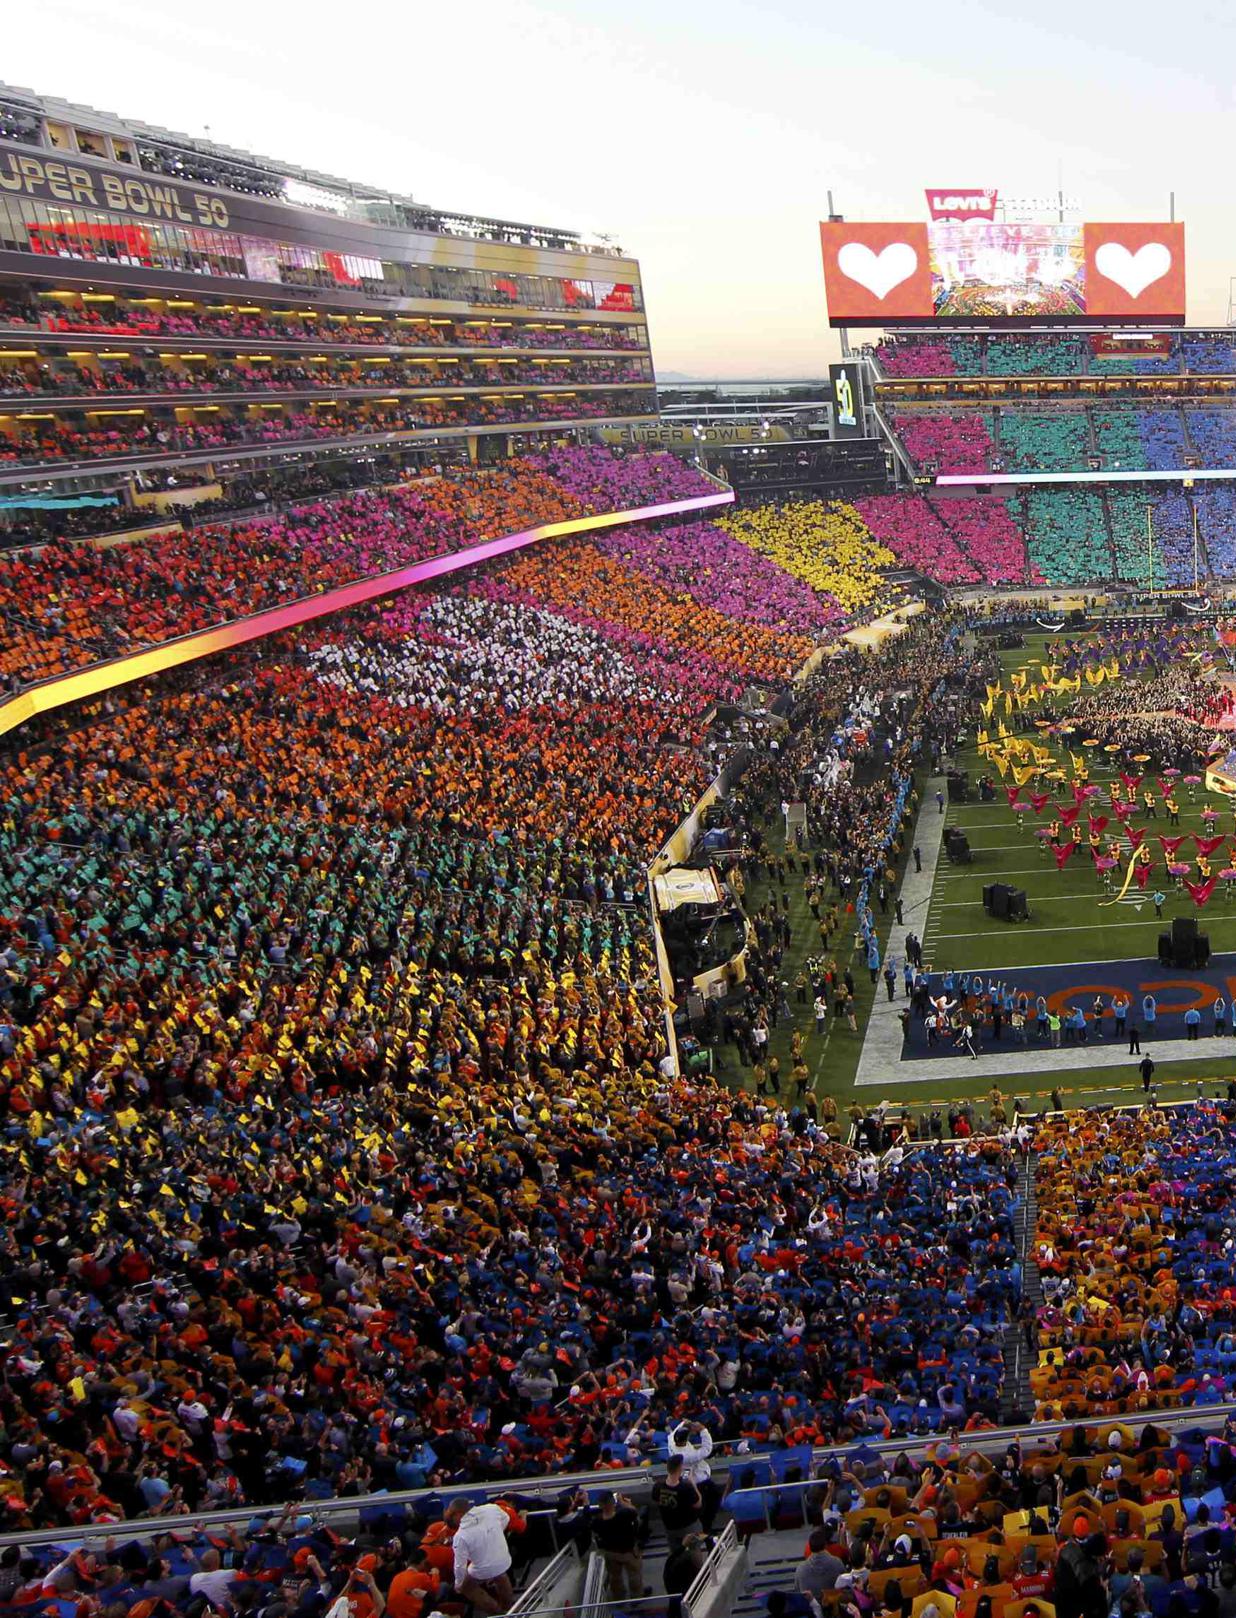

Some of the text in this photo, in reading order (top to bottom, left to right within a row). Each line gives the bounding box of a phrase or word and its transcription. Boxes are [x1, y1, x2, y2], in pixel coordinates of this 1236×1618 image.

[101, 174, 192, 222] BOWL
[194, 194, 229, 228] 50
[620, 430, 684, 442] SUPER
[701, 429, 745, 441] OWL
